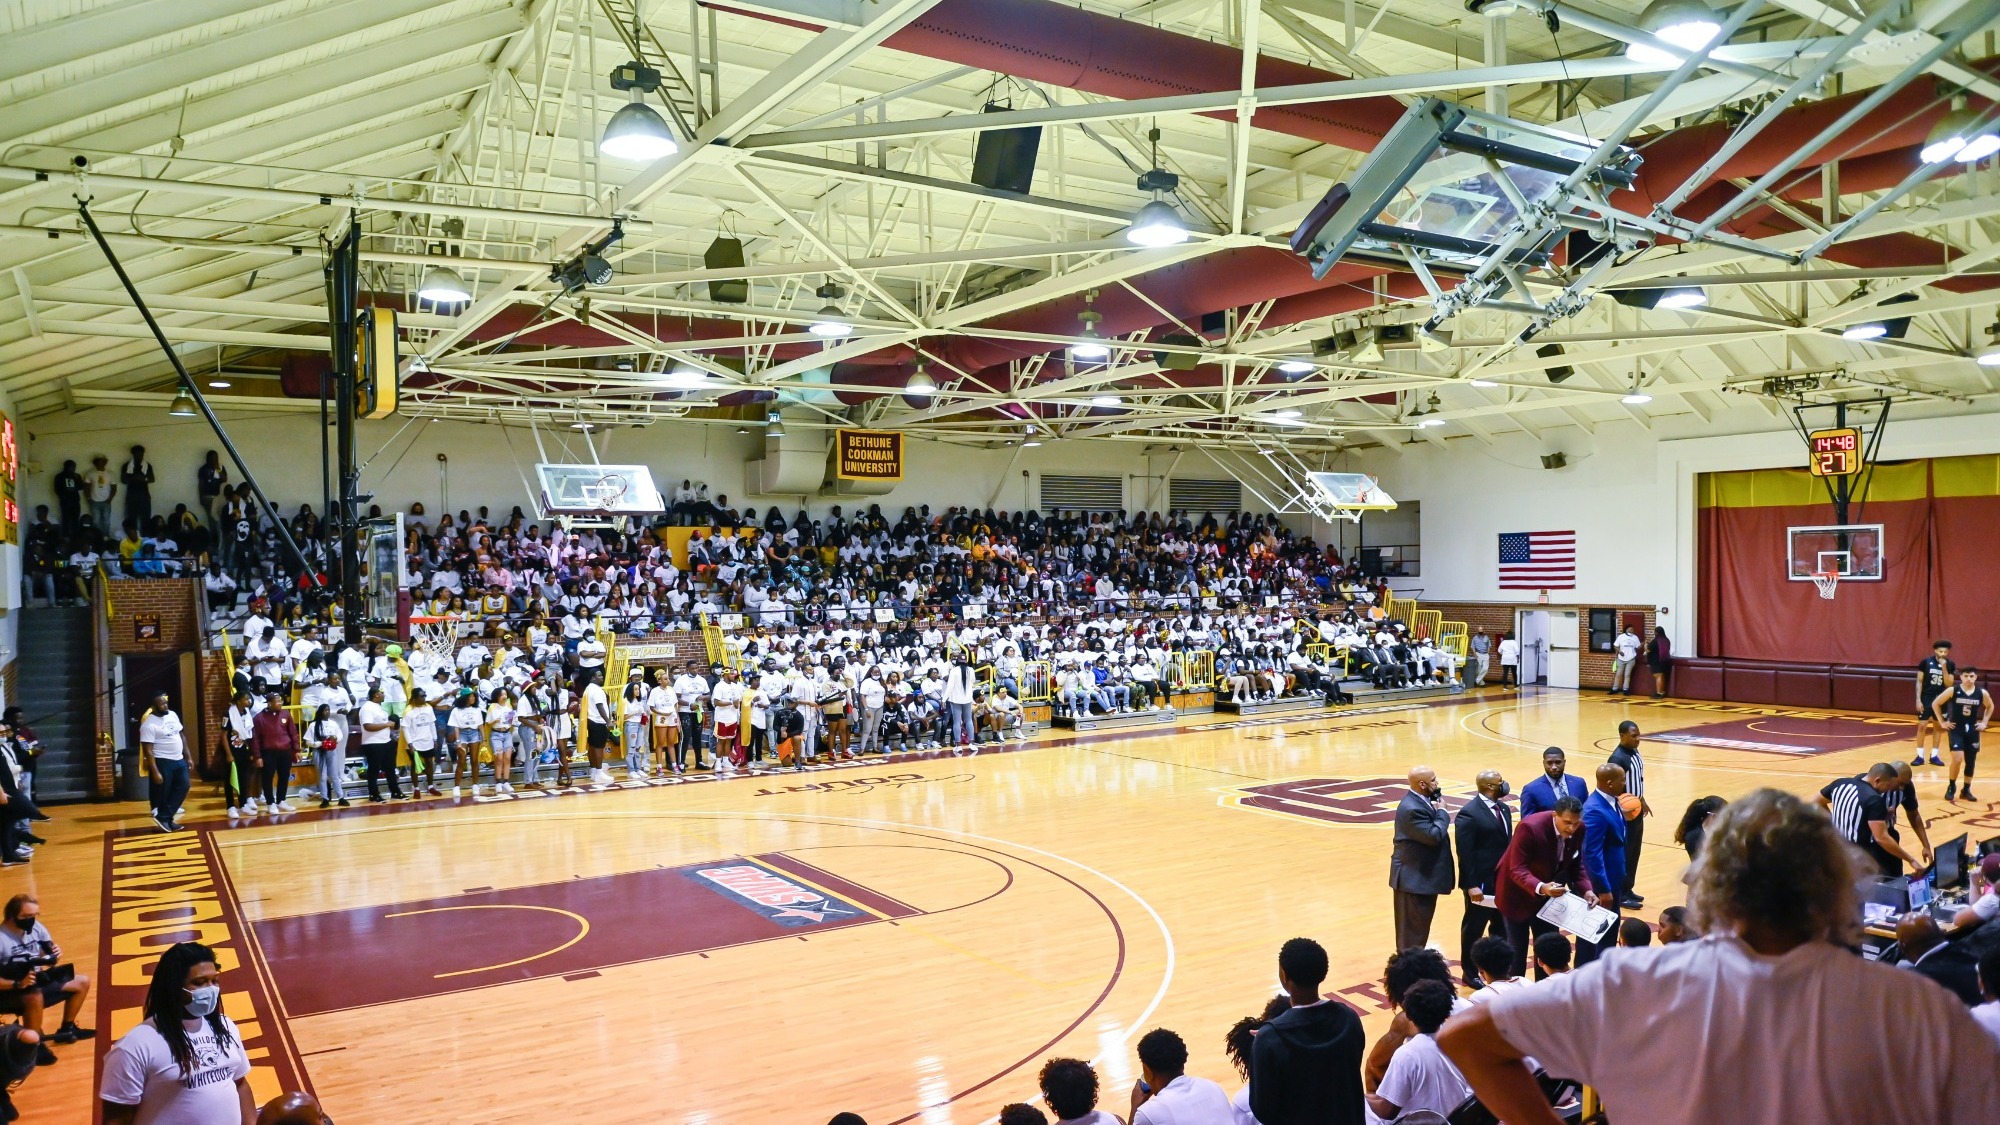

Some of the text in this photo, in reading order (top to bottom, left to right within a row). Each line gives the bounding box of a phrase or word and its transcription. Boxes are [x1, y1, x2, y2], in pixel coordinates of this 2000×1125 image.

[849, 436, 892, 448] BETHUNE
[847, 448, 894, 460] COOKMAN
[844, 461, 898, 473] UNIVERSITY
[1821, 452, 1846, 473] 27
[1930, 673, 1943, 686] 35
[1962, 704, 1972, 717] 5
[754, 773, 924, 797] COURT
[187, 1066, 230, 1090] WHITEOUT
